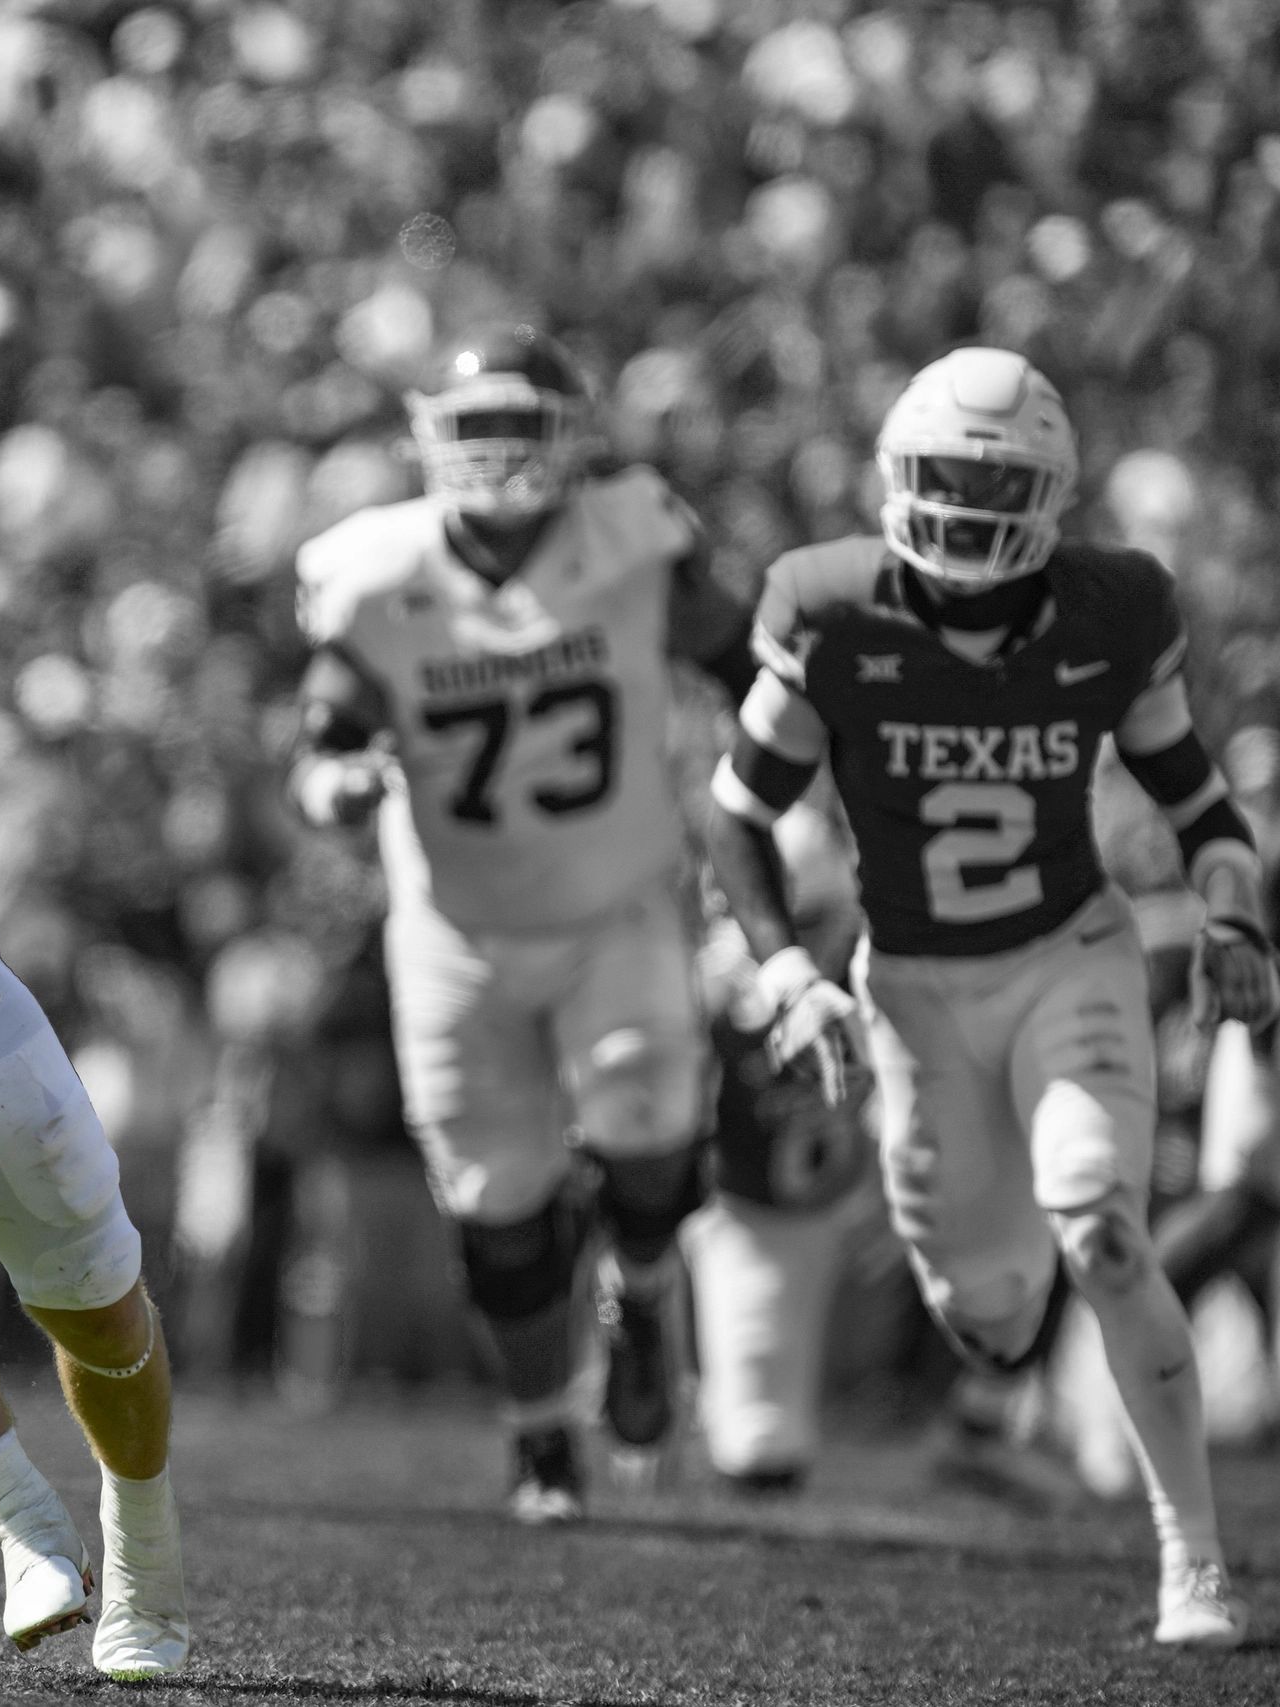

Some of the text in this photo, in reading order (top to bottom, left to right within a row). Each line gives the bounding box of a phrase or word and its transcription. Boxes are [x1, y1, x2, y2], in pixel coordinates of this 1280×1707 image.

[423, 682, 615, 824] 73
[877, 719, 1079, 780] TEXAS
[919, 781, 1045, 925] 2
